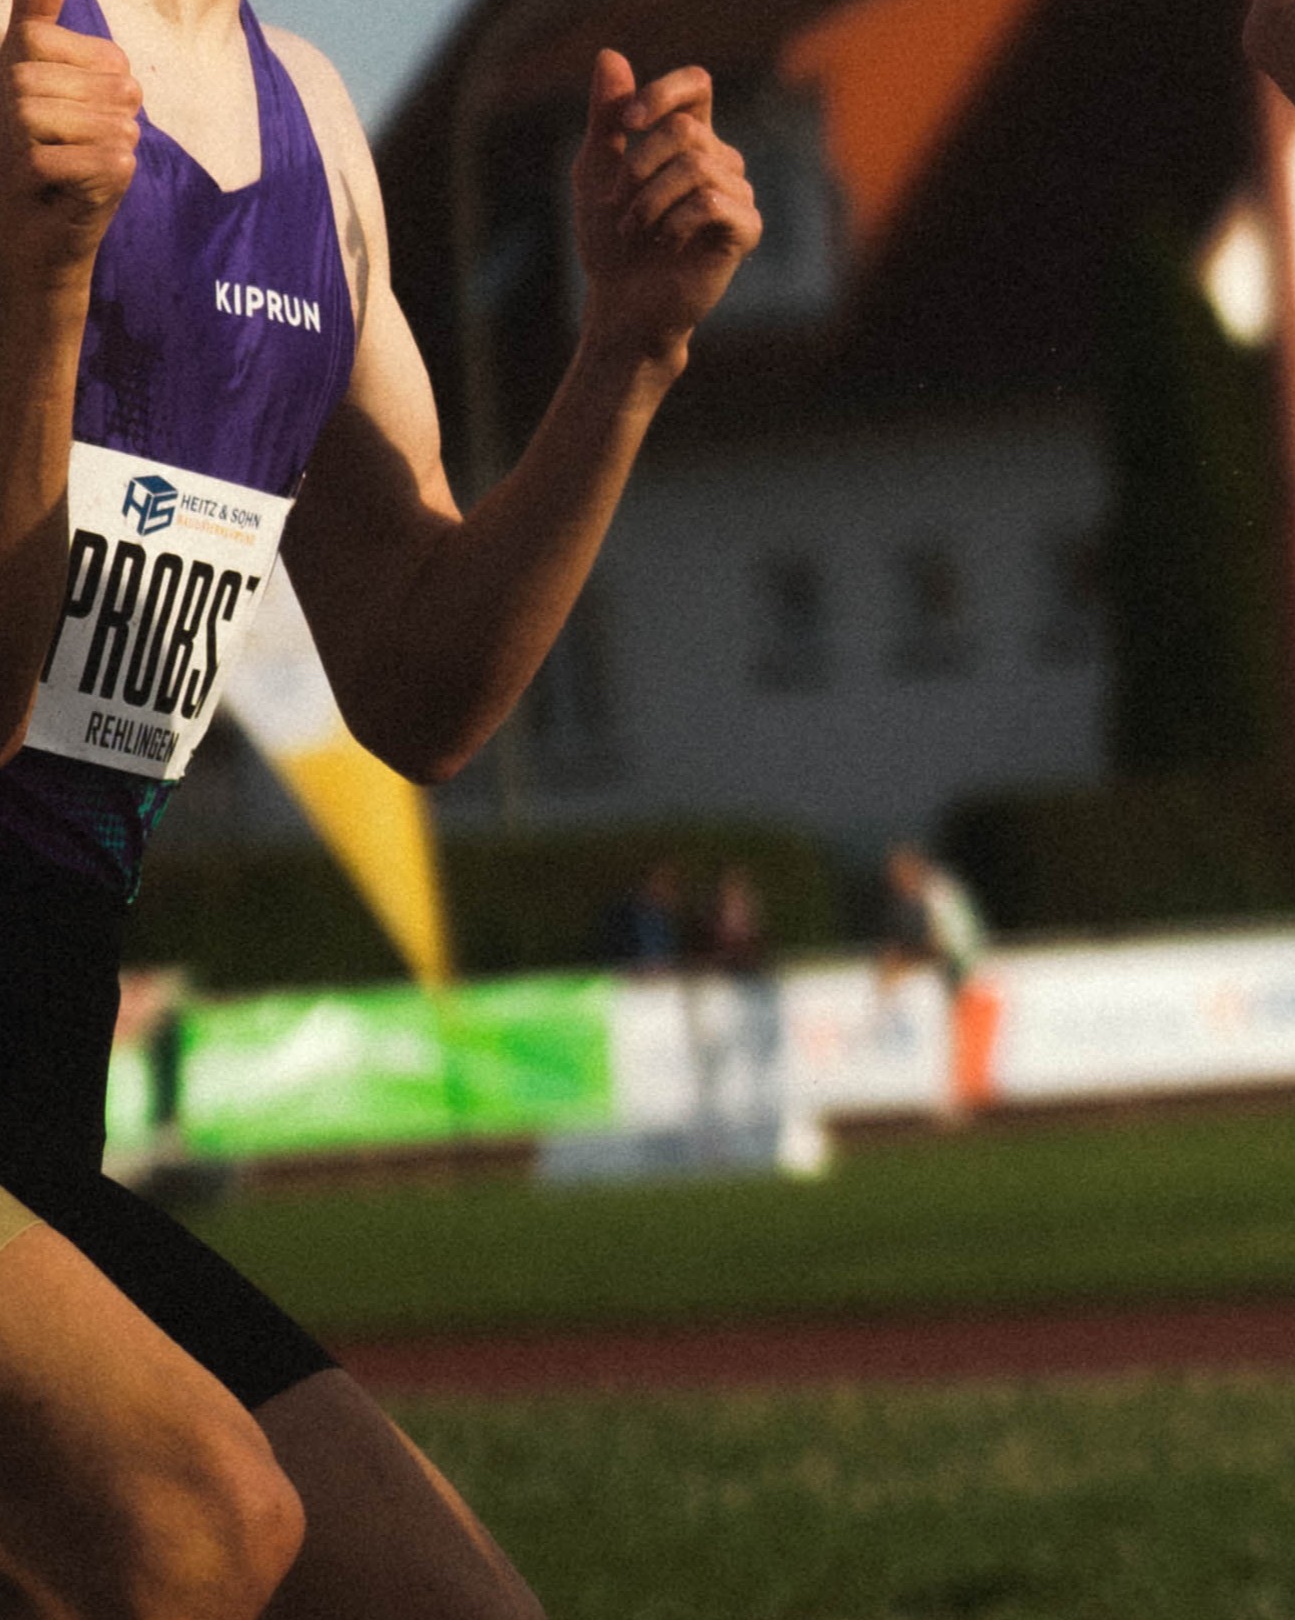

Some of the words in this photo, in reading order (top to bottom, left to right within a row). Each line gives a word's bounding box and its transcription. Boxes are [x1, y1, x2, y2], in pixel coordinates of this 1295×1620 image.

[215, 279, 321, 334] KIPRUN
[180, 494, 219, 517] HEITZ
[218, 505, 228, 520] &
[230, 507, 262, 529] SOHN
[84, 711, 180, 763] REHLINGEN
